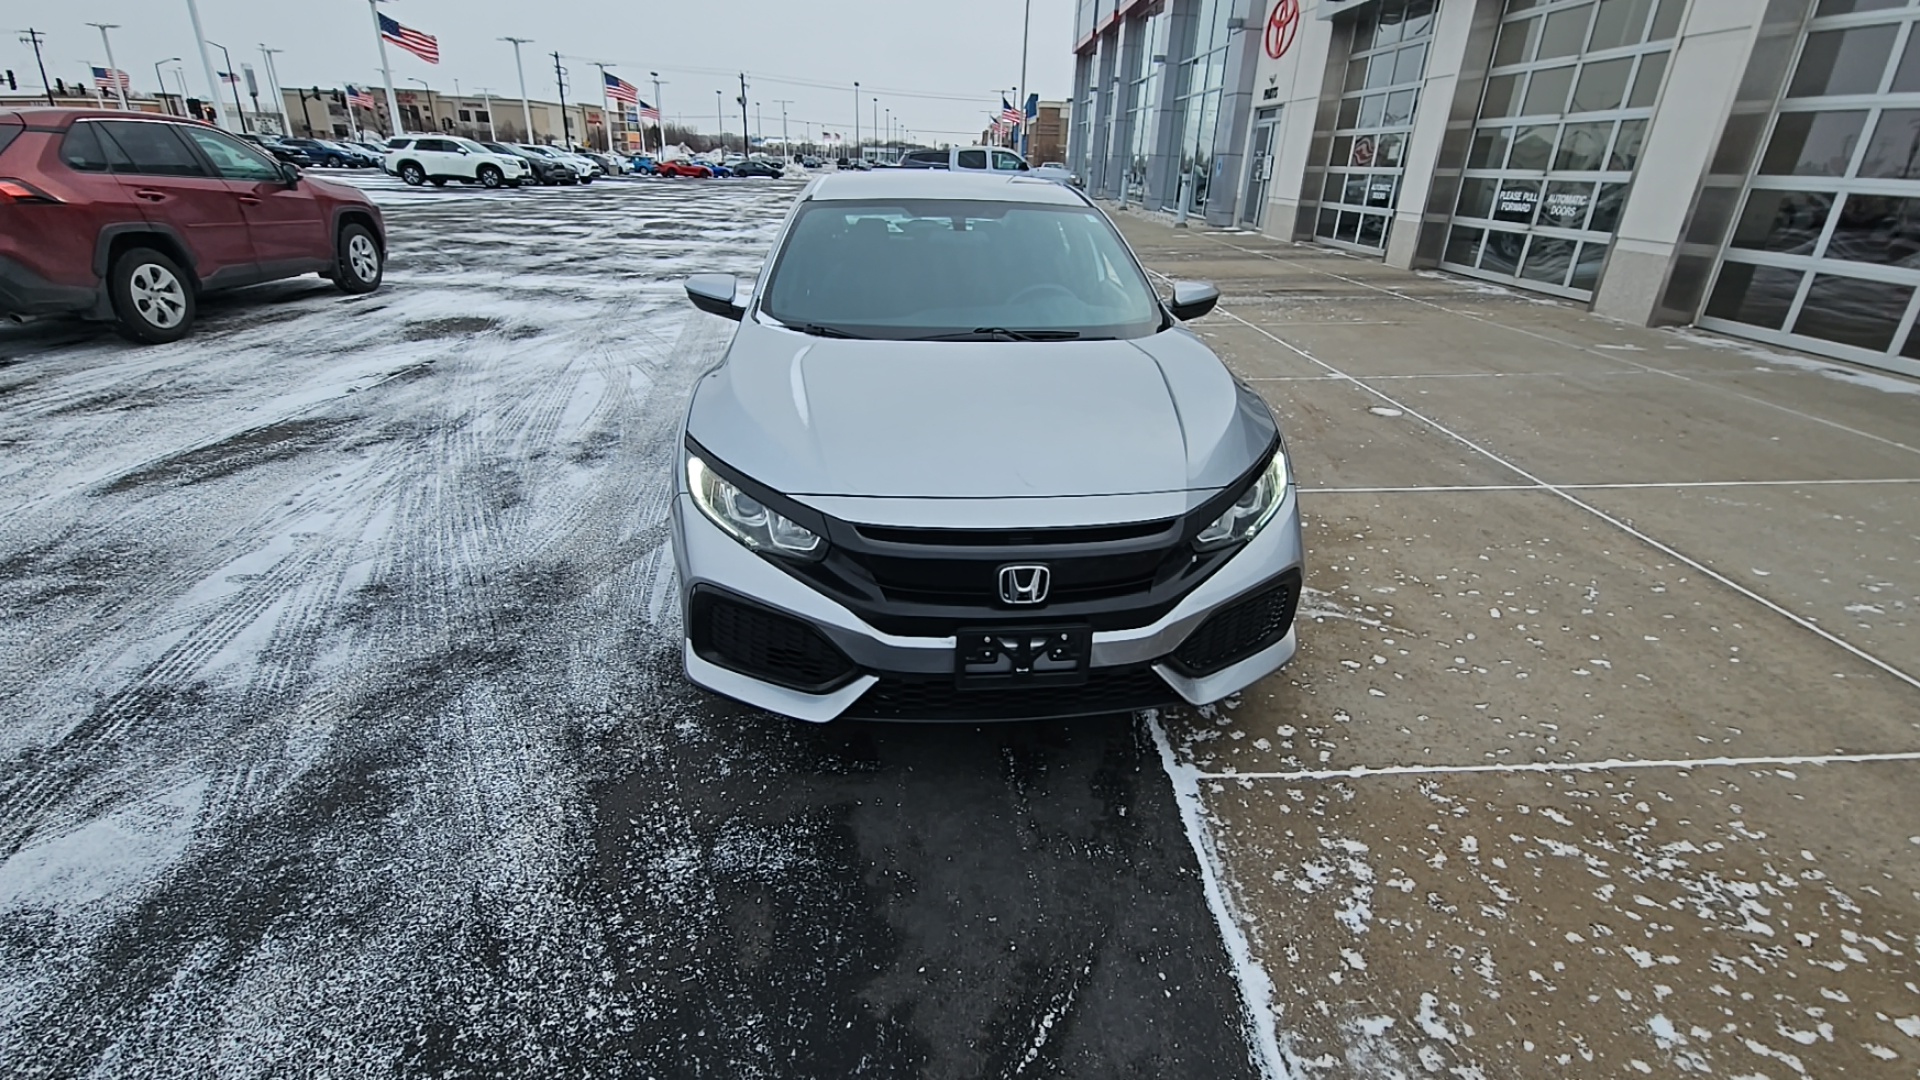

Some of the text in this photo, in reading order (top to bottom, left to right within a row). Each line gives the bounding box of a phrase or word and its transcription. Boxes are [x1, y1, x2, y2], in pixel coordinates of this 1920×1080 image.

[1500, 191, 1538, 202] PLEASE PULL
[1547, 194, 1587, 205] AUTOMATIC
[1501, 202, 1531, 212] FORWARD
[1551, 205, 1576, 216] DOORS
